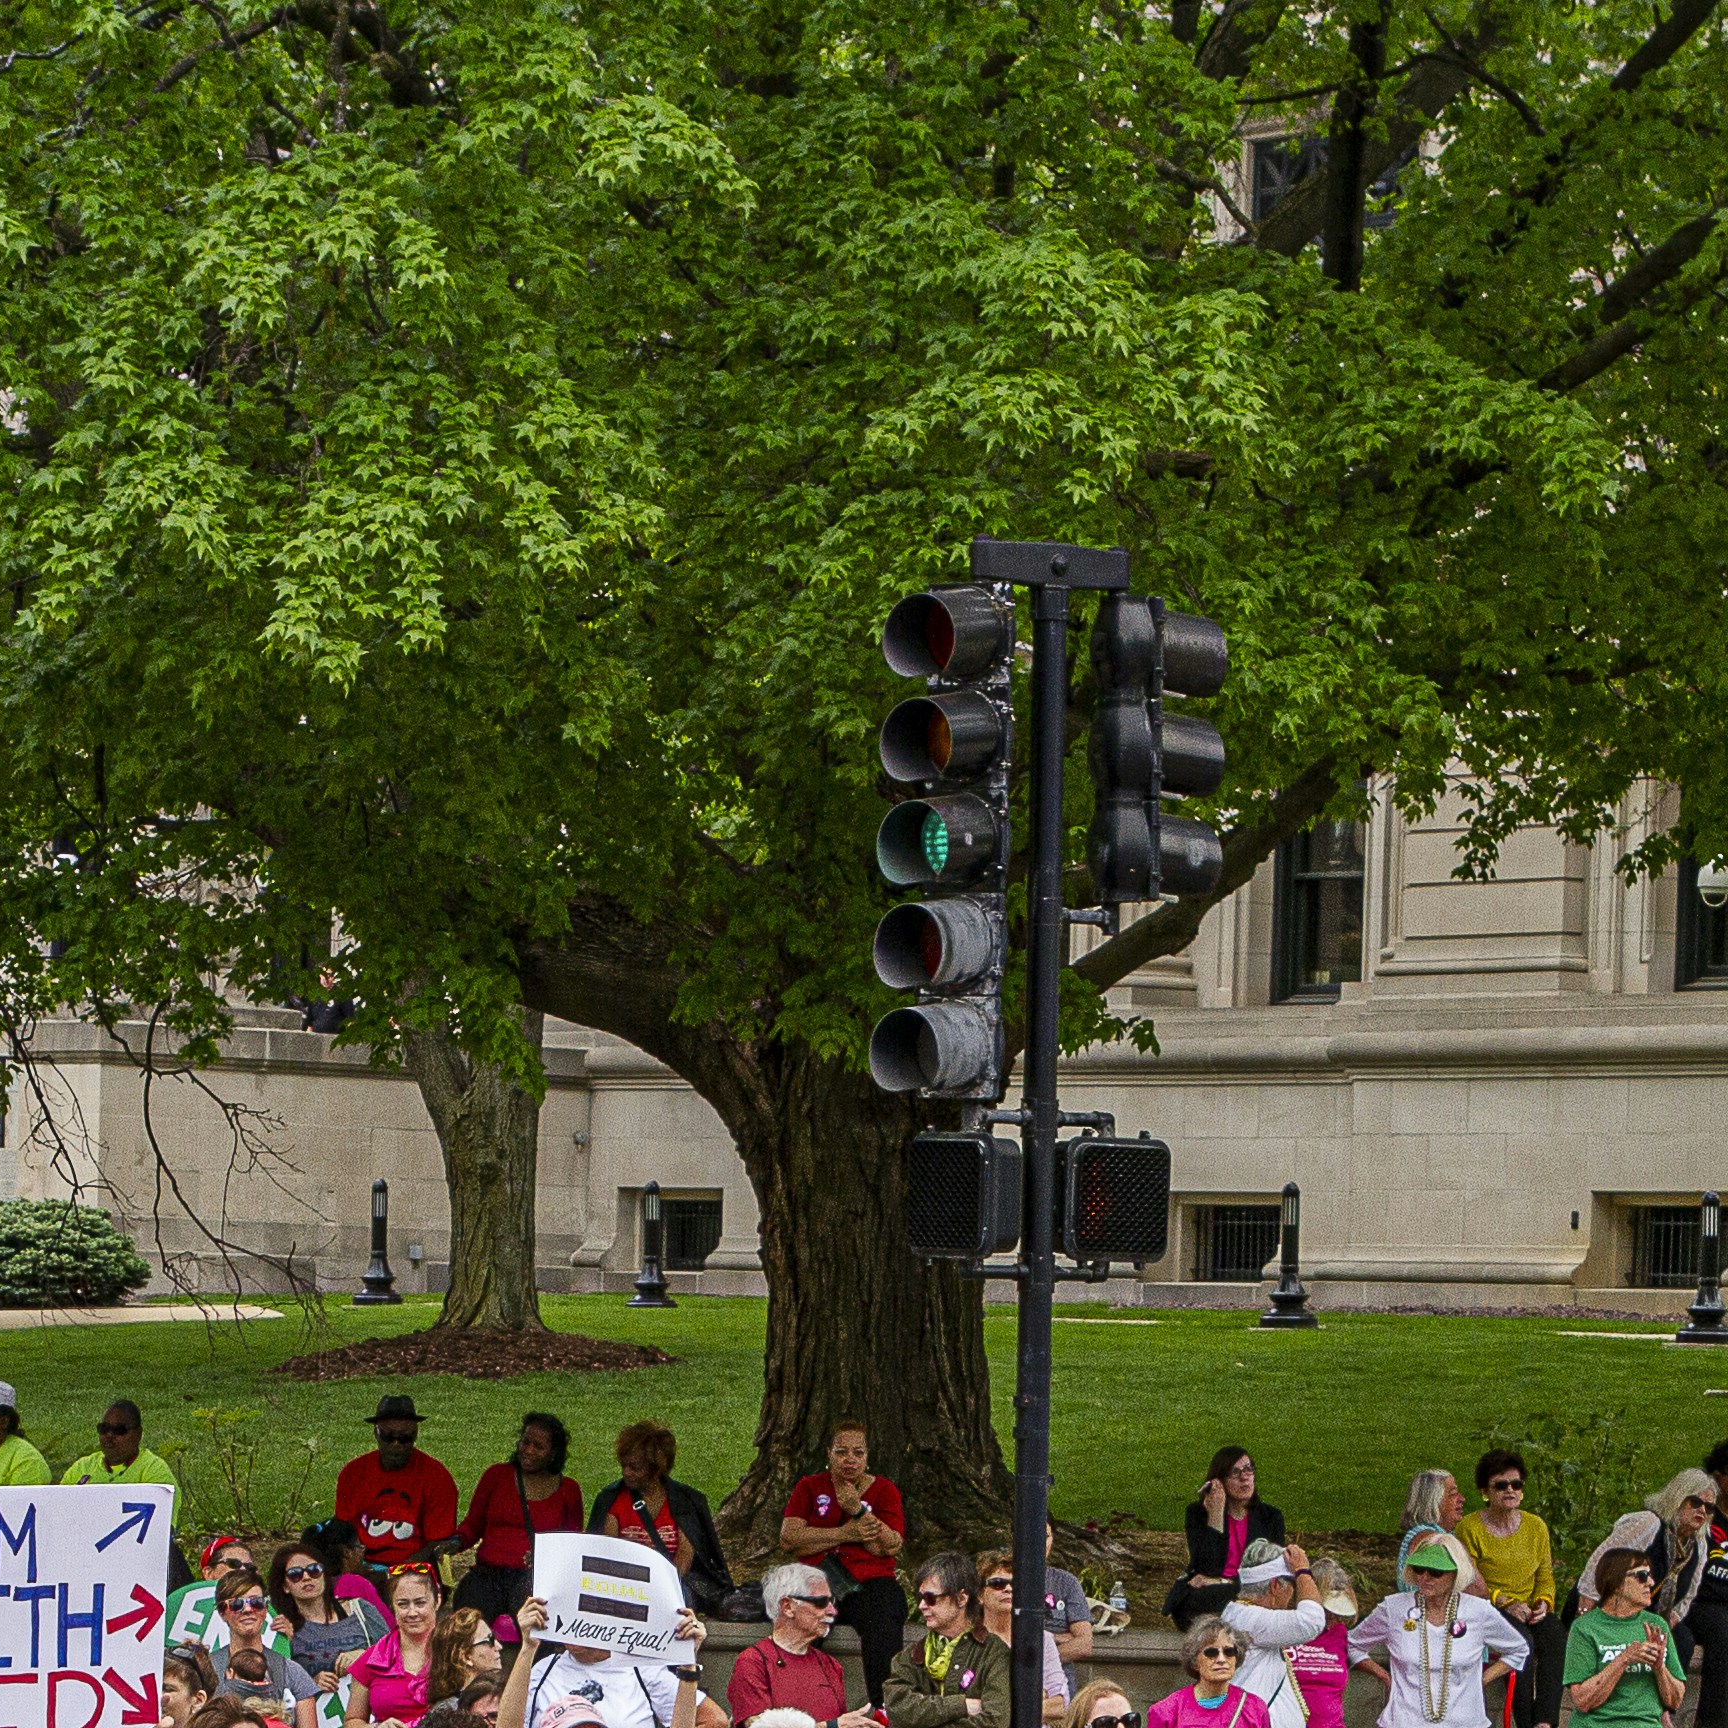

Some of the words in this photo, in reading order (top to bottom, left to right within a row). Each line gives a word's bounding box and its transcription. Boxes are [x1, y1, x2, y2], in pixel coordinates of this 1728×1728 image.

[581, 1576, 651, 1602] EQUAL
[562, 1618, 617, 1643] Means
[617, 1626, 676, 1654] Equal!
